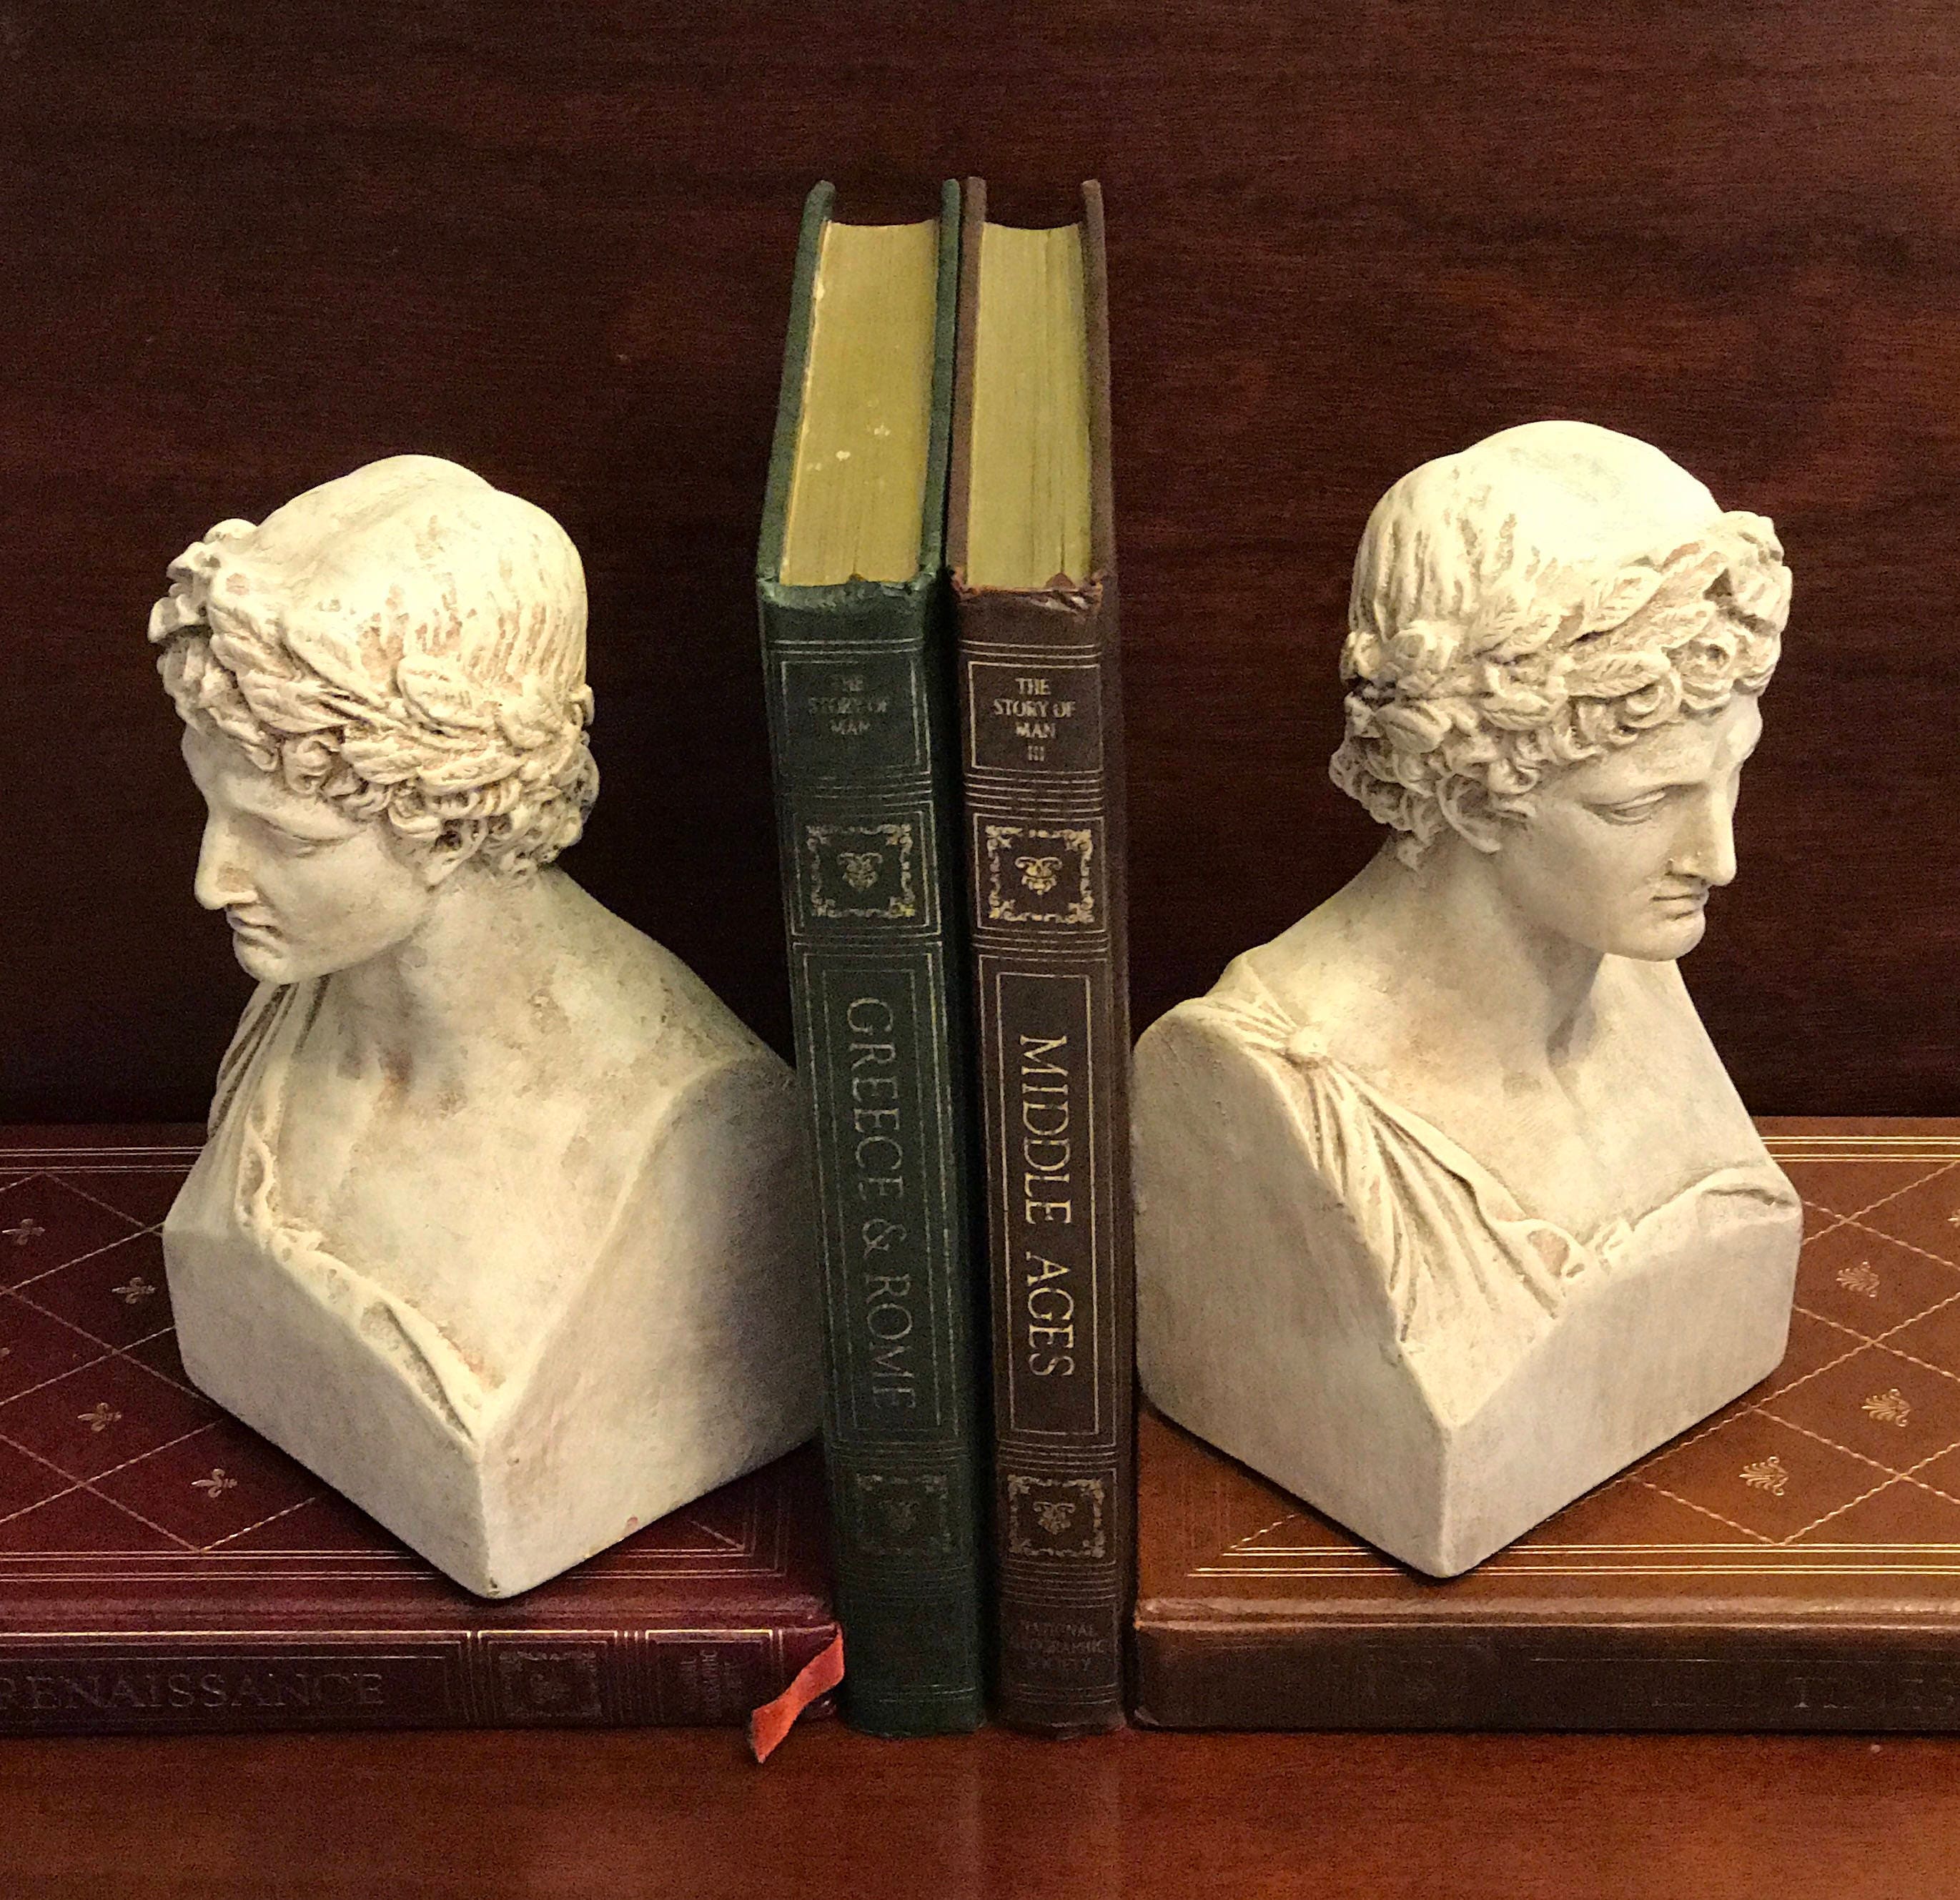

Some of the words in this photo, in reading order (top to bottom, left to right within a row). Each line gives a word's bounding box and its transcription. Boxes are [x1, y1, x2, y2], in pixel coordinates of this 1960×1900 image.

[1015, 677, 1051, 695] THE
[993, 698, 1050, 718] STORY
[1052, 701, 1076, 718] OF
[1014, 721, 1057, 738] MAN
[1027, 745, 1045, 762] III
[846, 996, 904, 1202] GREECE
[1019, 1034, 1072, 1226] MIDDLE
[862, 1217, 908, 1260] &
[1025, 1251, 1076, 1377] AGES
[864, 1273, 916, 1408] ROME
